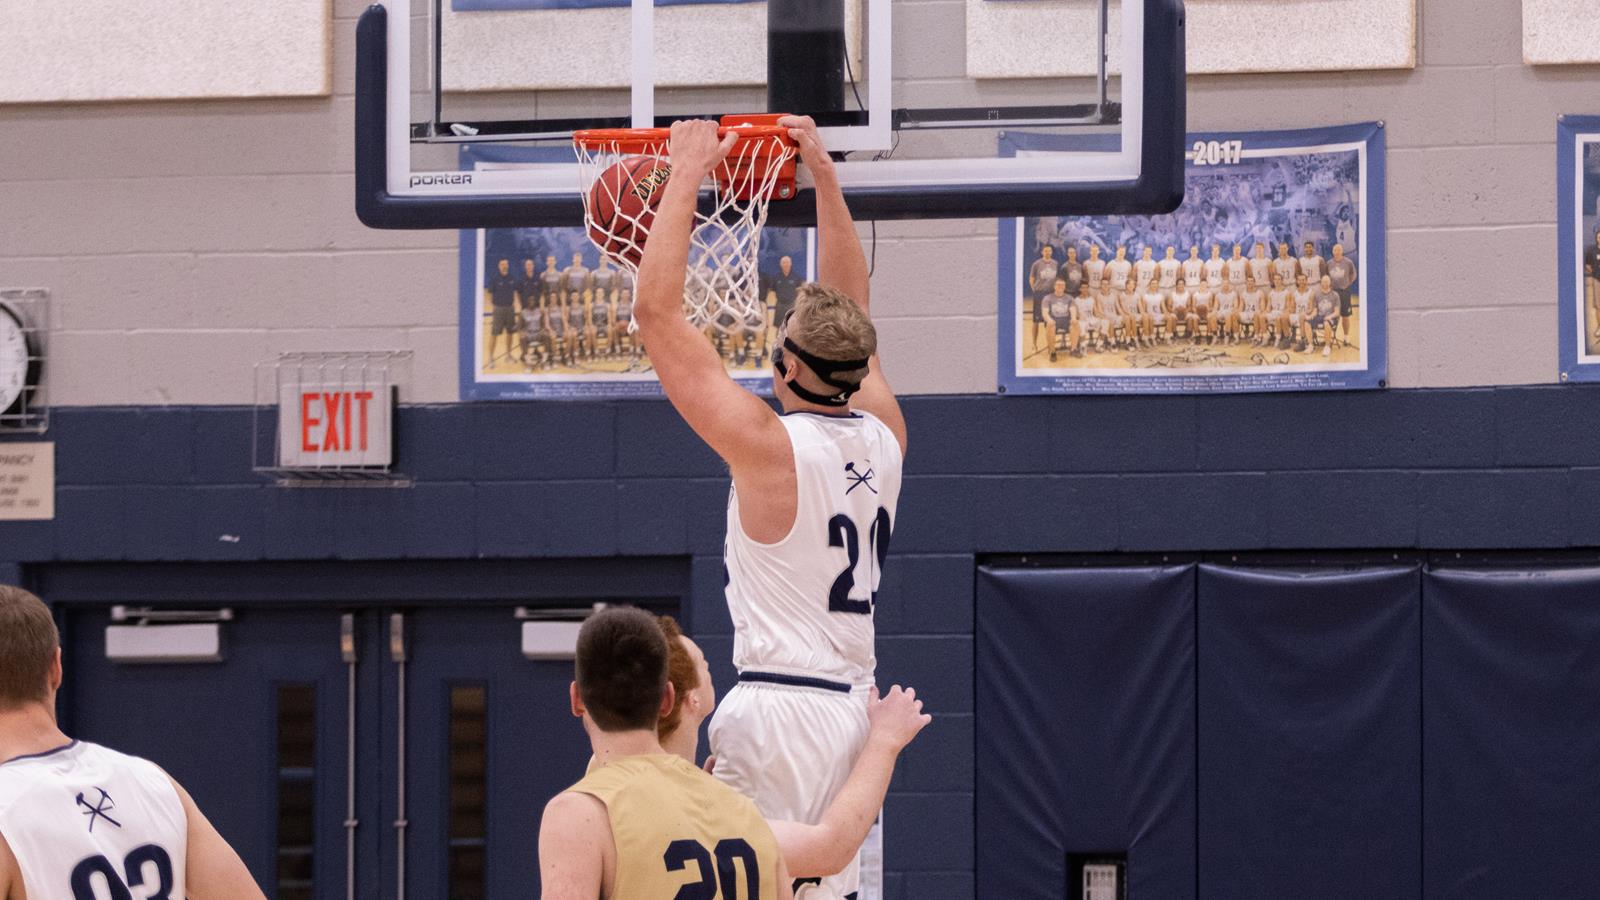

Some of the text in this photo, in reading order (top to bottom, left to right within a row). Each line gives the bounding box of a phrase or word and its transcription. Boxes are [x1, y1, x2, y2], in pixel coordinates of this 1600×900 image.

[1193, 140, 1242, 165] 2017
[302, 392, 373, 452] EXIT
[663, 838, 760, 900] 20
